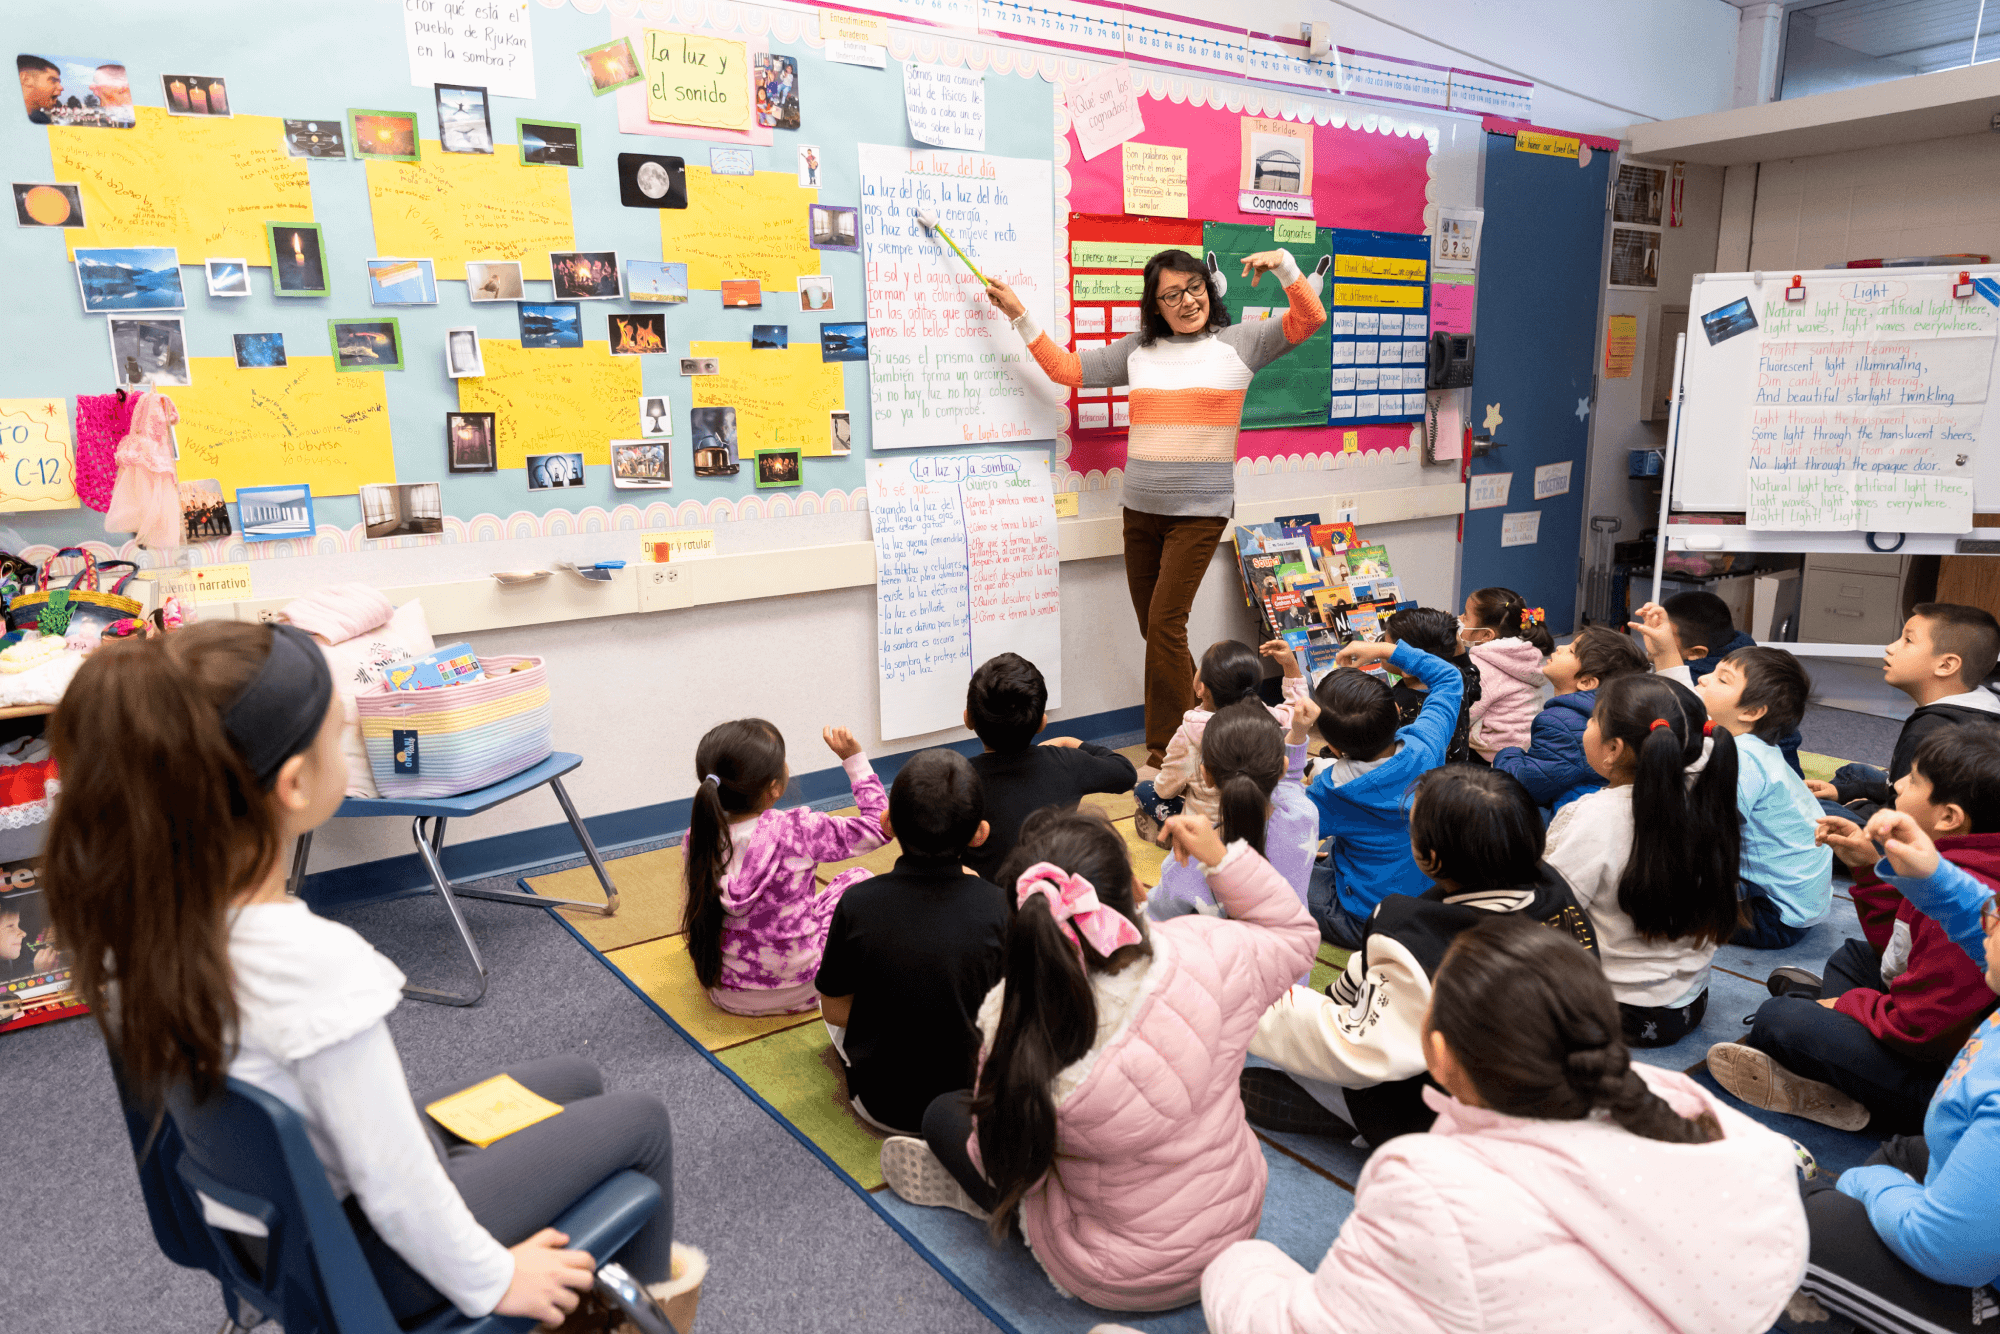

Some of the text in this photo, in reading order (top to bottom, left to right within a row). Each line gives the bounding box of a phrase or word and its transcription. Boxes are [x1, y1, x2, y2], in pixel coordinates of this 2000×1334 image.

[445, 1, 465, 20] qué
[475, 2, 498, 20] está
[510, 9, 519, 22] el
[830, 13, 878, 28] Entendimientos
[415, 21, 453, 35] pueblo
[464, 25, 478, 39] de
[982, 8, 1120, 39] 71 72 73 74 75 76 77 78 79 80
[418, 45, 433, 57] en
[444, 42, 454, 58] la
[651, 33, 727, 74] La luz y
[937, 73, 950, 83] una
[652, 72, 727, 103] el sonido
[927, 84, 936, 100] de
[1100, 90, 1113, 104] son
[1116, 78, 1128, 94] los
[1089, 95, 1128, 131] cognados?
[1254, 120, 1296, 137] The Bridge
[910, 151, 995, 177] La luz del día
[863, 175, 1008, 205] La luz del día, la luz del día
[1253, 196, 1298, 211] Cognados
[1279, 224, 1311, 241] Cognates
[1125, 287, 1132, 295] es
[1853, 283, 1889, 301] Light
[1765, 299, 1990, 322] Natural light here, artificial light there,
[870, 320, 991, 338] vemos los bellos colores.
[870, 345, 881, 365] Si
[886, 354, 910, 364] usas
[919, 345, 928, 364] el
[936, 354, 973, 369] prisma
[980, 354, 996, 363] con
[1002, 353, 1020, 363] una
[1759, 354, 1927, 378] Fluorescent light illuminating,
[872, 366, 914, 383] también
[923, 366, 950, 381] forma
[957, 370, 968, 380] un
[1756, 386, 1954, 406] And beautiful starlight twinkling
[963, 421, 1031, 441] Por Lupita Gallardo
[1752, 425, 1976, 447] Some light through the translucent sheers,
[15, 458, 61, 486] C-12
[917, 456, 1015, 480] La luz y la sombra
[1750, 456, 1940, 477] No light through the opaque door.
[876, 479, 887, 497] Yo
[894, 482, 906, 495] sé
[1475, 486, 1503, 501] TEAM
[1751, 508, 1784, 526] Light!
[1790, 508, 1821, 526] Light!
[677, 541, 681, 553] y
[684, 539, 710, 550] rotular
[1253, 556, 1280, 568] Sound
[199, 579, 246, 591] narrativo
[895, 605, 906, 618] luz
[920, 601, 945, 616] brillante
[999, 612, 1006, 620] se
[1008, 607, 1027, 619] forma
